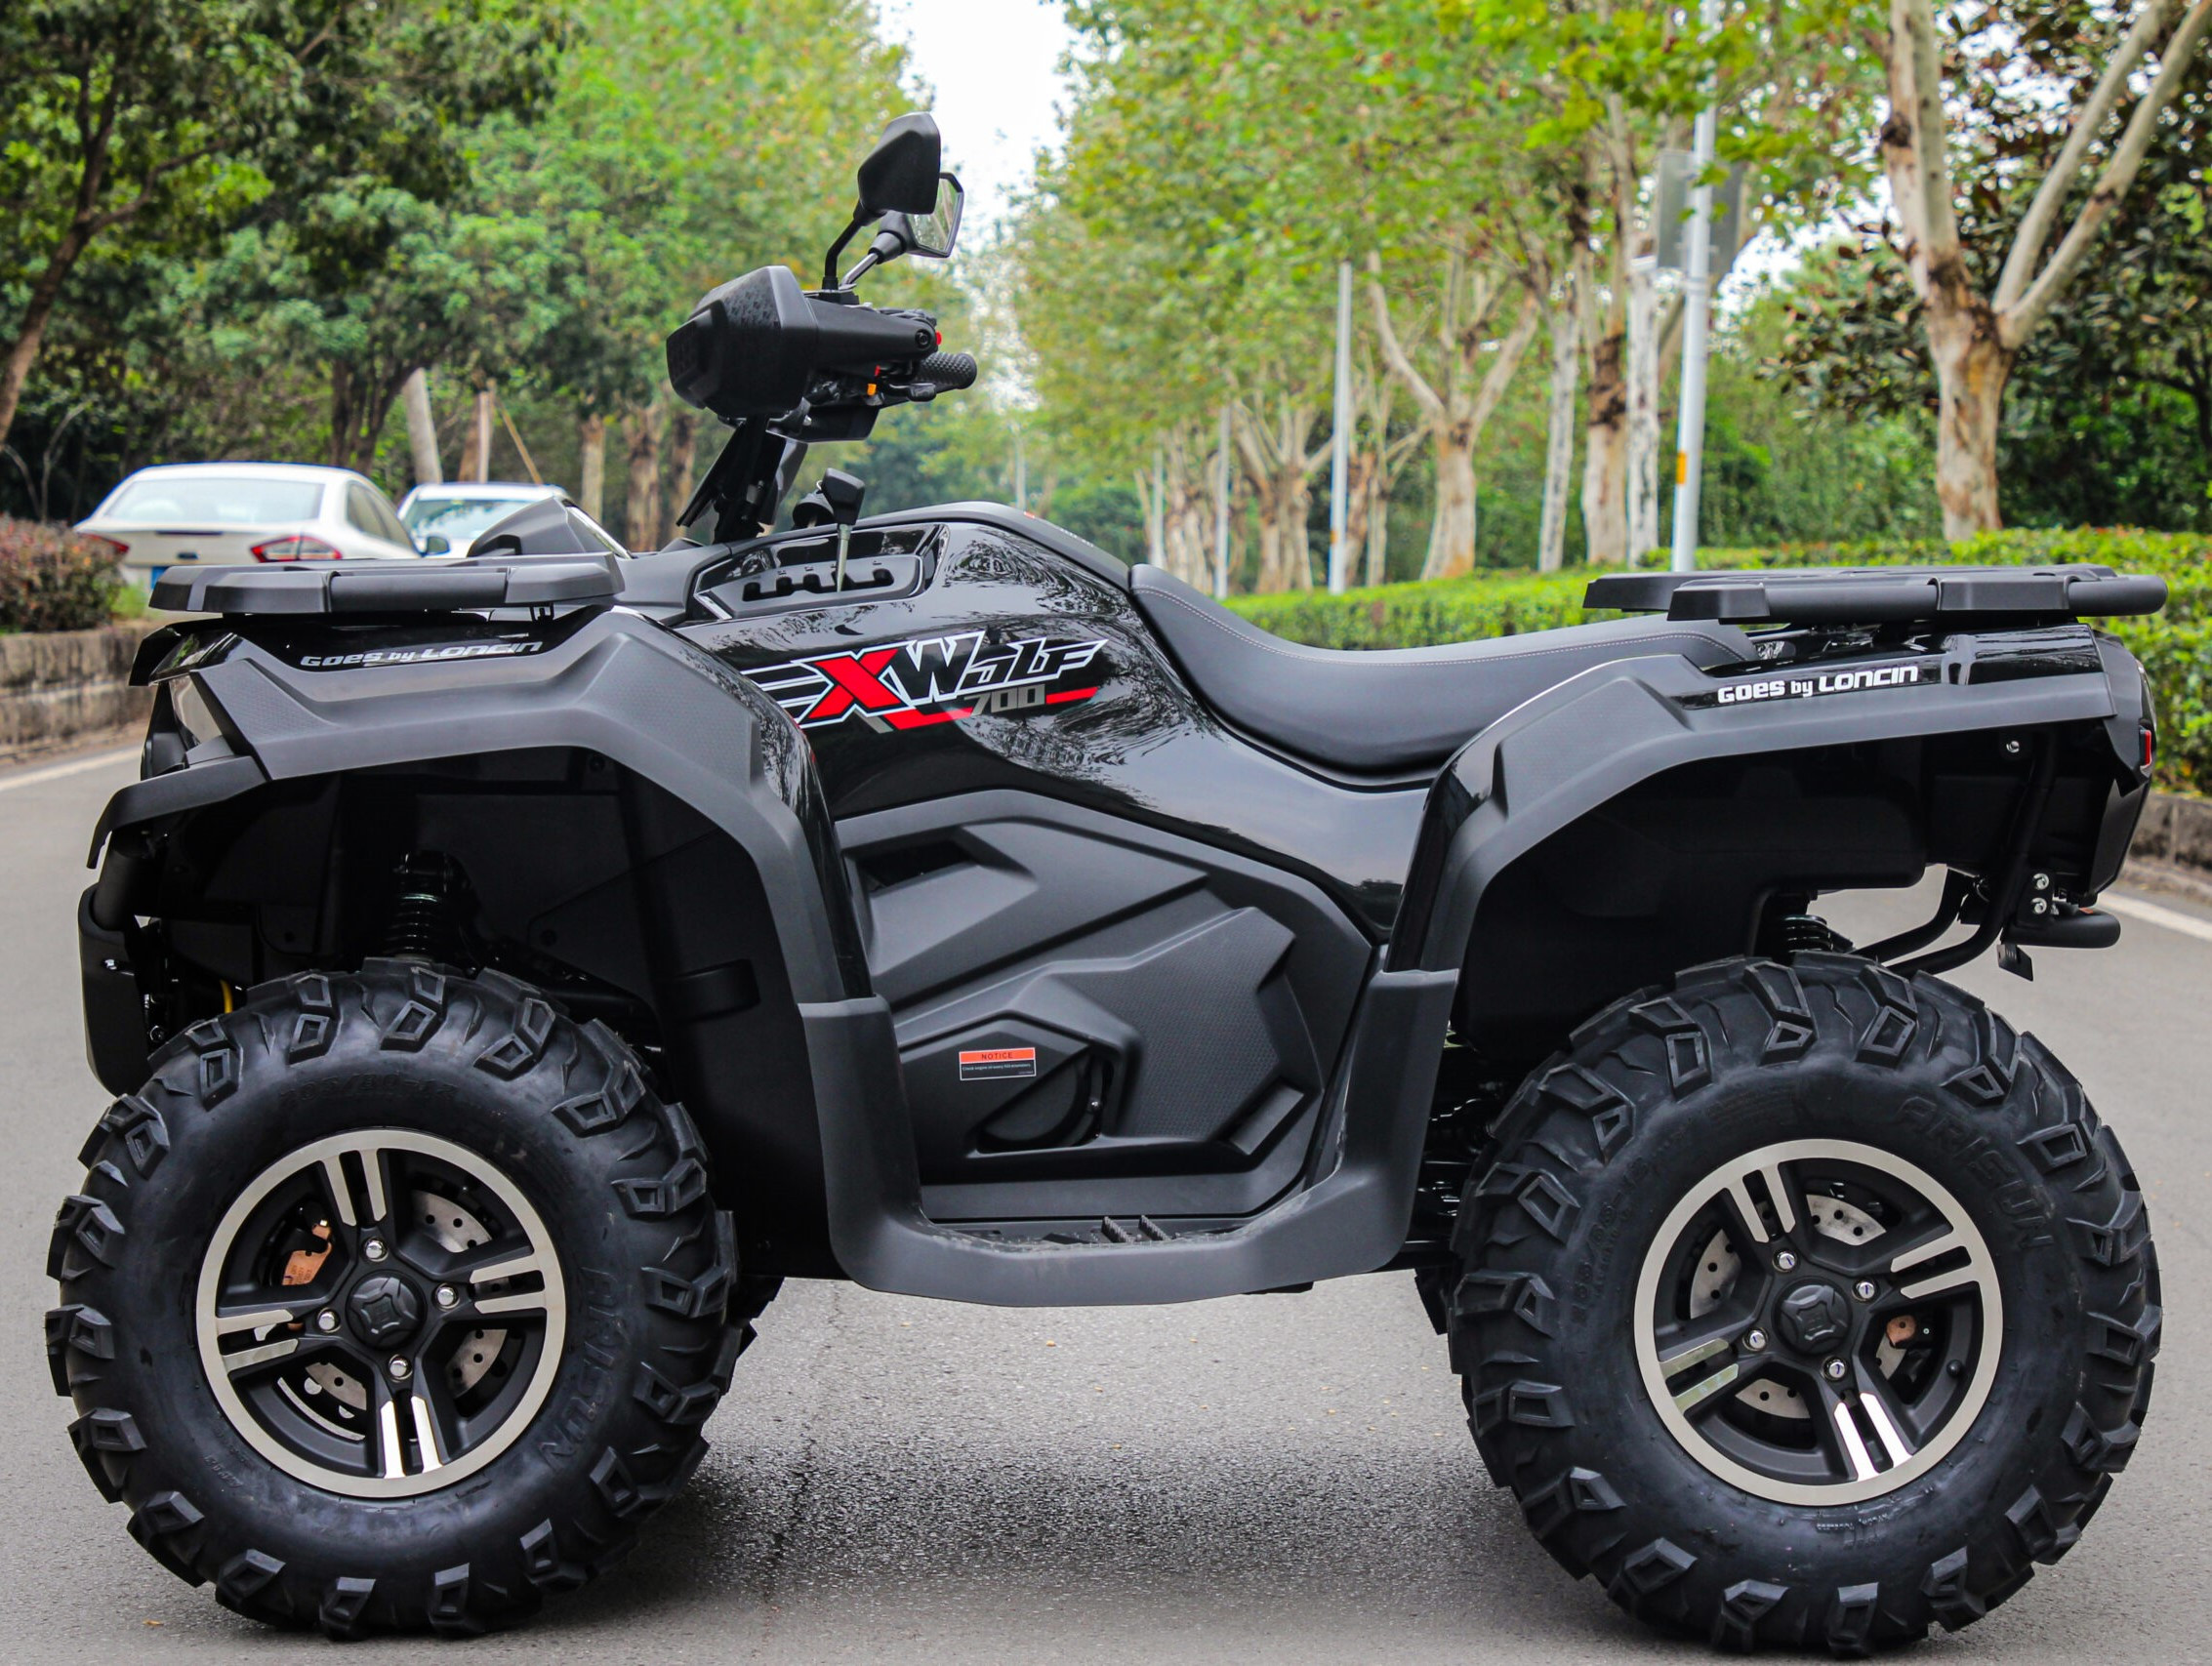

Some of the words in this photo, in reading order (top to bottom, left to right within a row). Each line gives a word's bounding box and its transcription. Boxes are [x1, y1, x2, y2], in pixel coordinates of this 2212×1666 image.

[388, 650, 416, 664] by
[1790, 680, 1814, 698] by
[963, 684, 1046, 716] 700
[981, 1051, 1013, 1060] NOTICE
